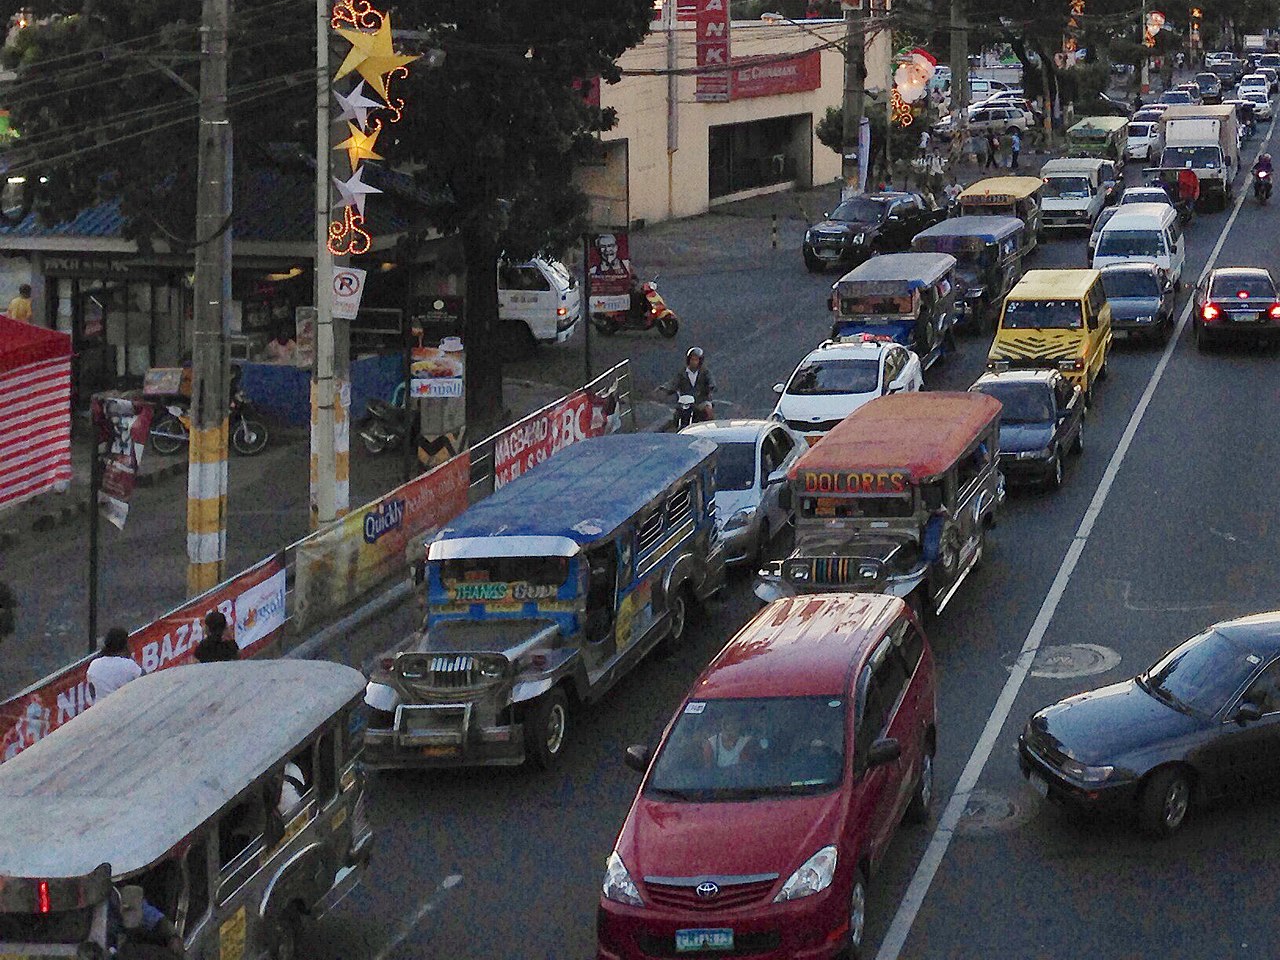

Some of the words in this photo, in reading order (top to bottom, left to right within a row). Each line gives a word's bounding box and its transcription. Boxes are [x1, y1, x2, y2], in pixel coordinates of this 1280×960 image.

[805, 471, 905, 494] DOLORES
[366, 501, 403, 539] Quickly
[142, 599, 237, 674] BAZAR
